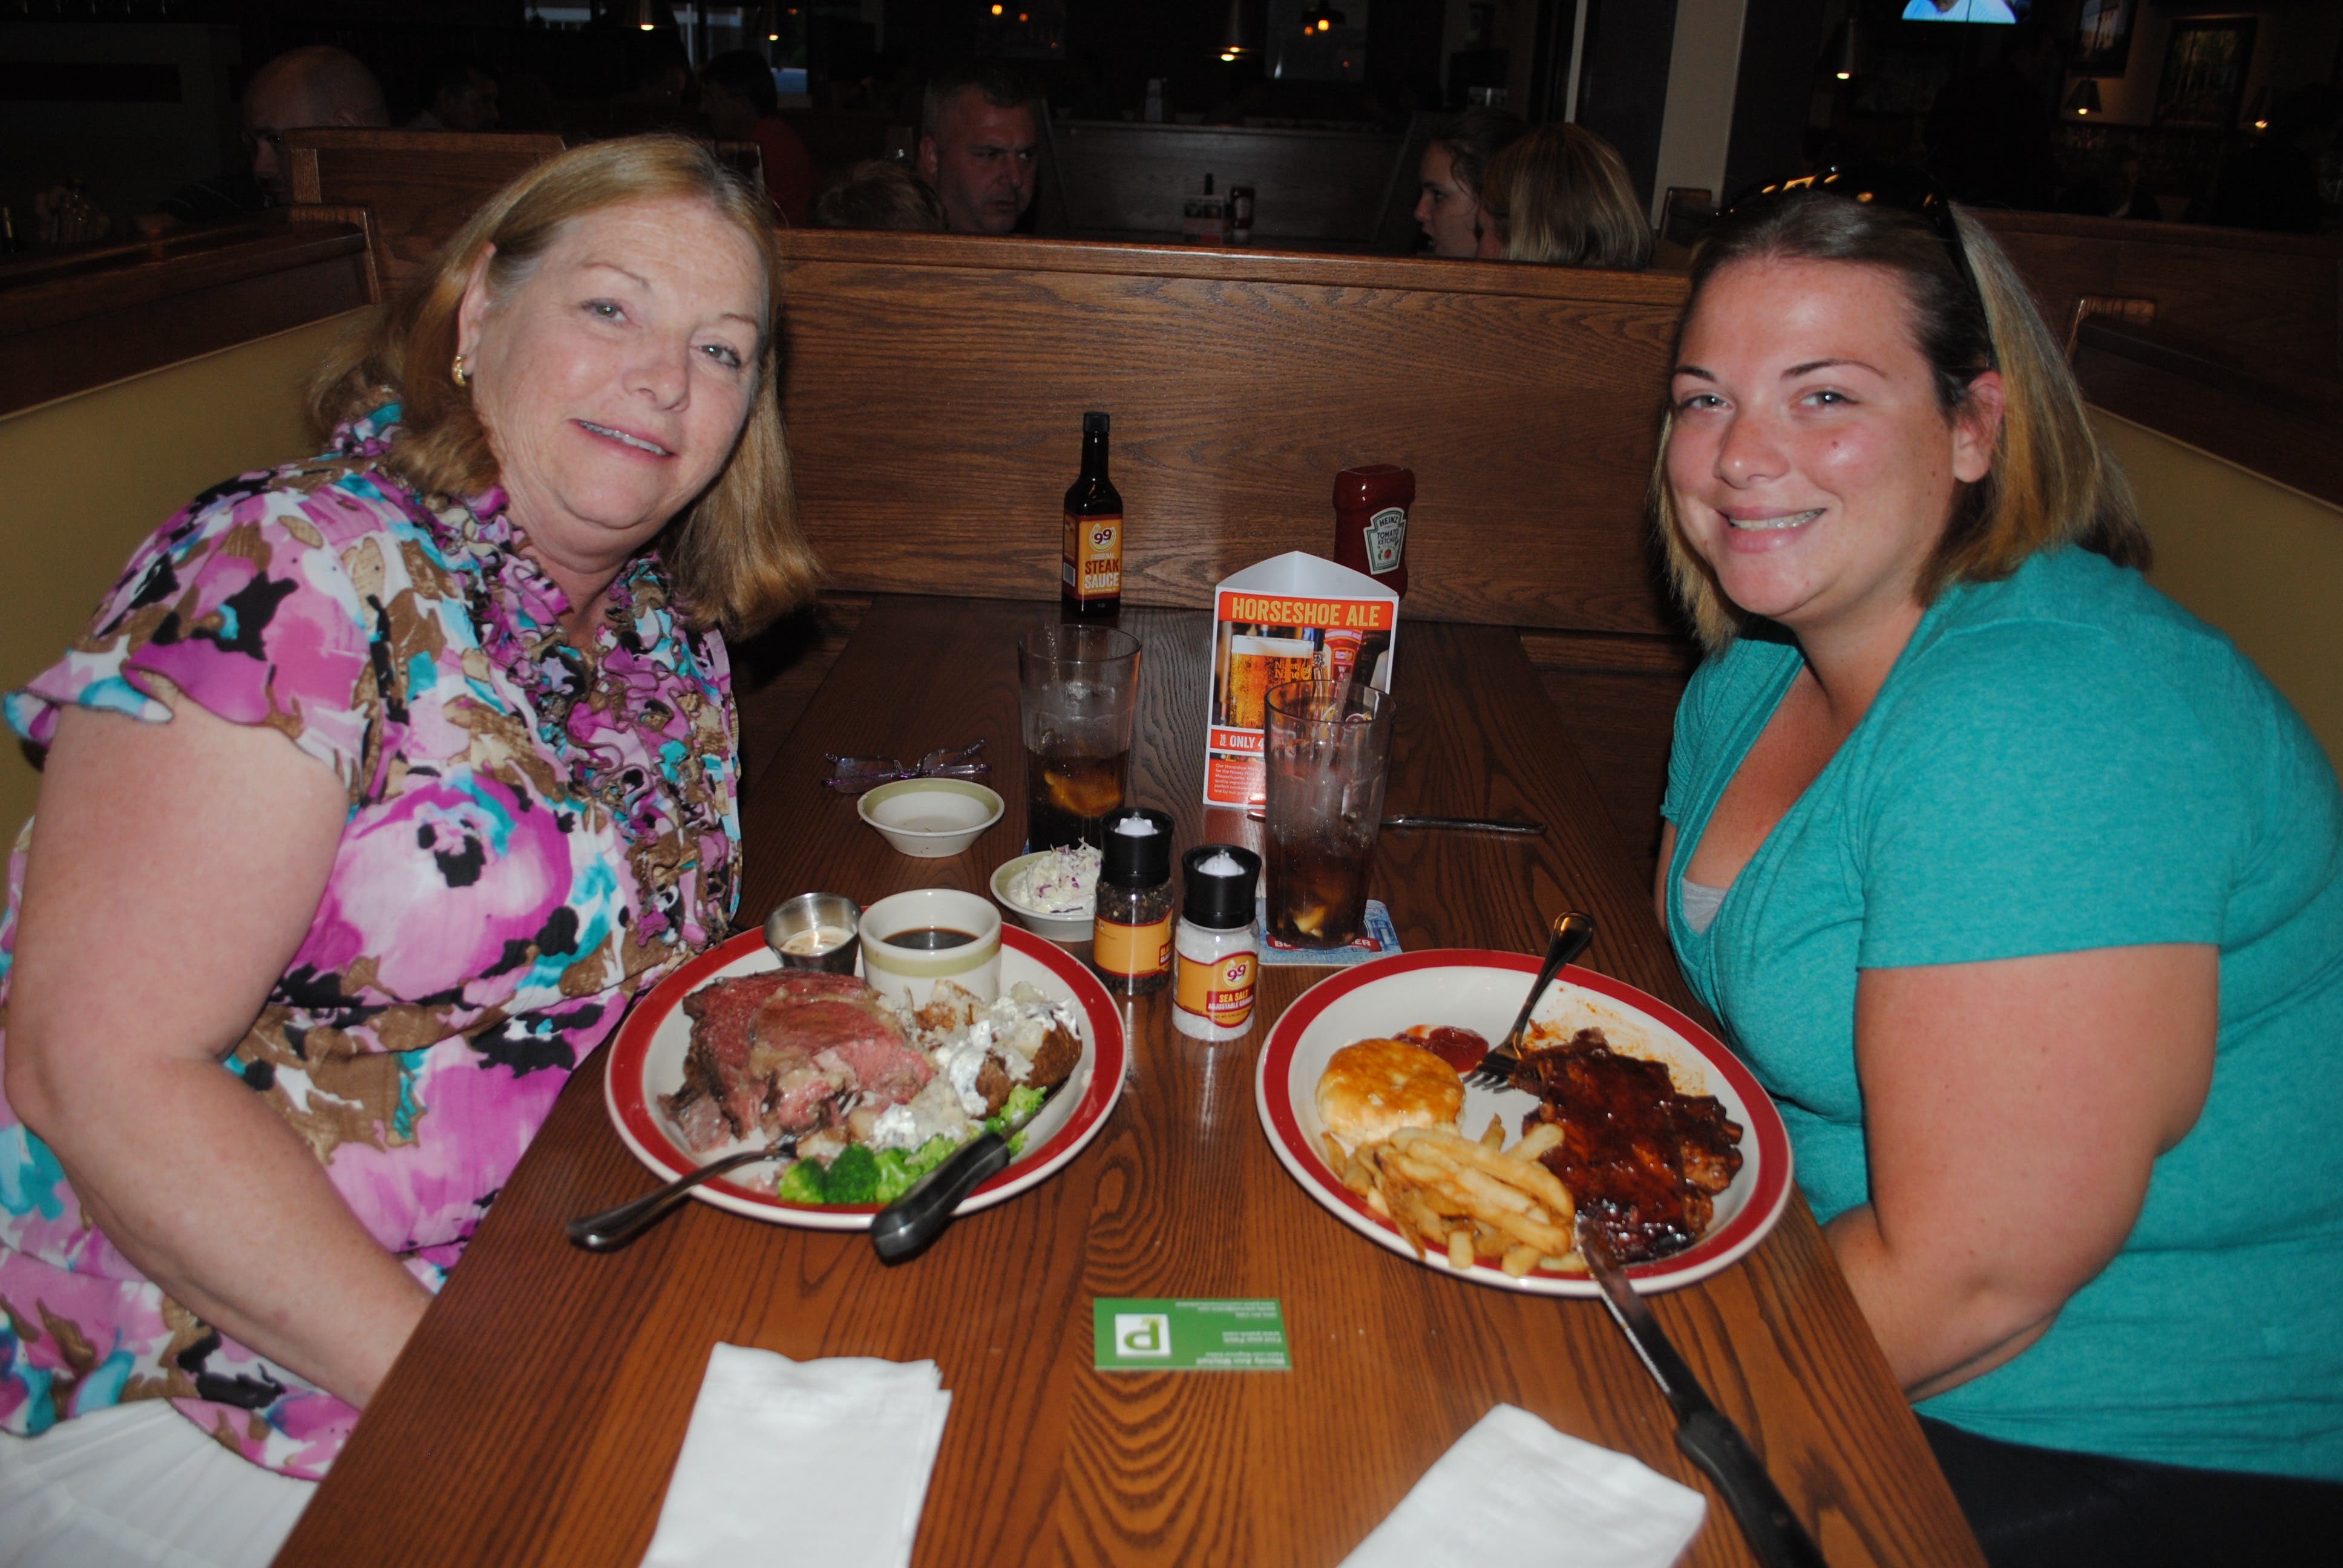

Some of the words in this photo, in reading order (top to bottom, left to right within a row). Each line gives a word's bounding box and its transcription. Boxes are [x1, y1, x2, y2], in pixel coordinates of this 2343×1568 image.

[1378, 516, 1398, 526] HEINZ
[1094, 529, 1112, 544] 99
[1377, 529, 1398, 539] TOMATO
[1085, 558, 1119, 574] STEAK
[1084, 572, 1119, 589] SAUCE
[1231, 597, 1340, 626] HORSESHOE
[1345, 605, 1380, 627] ALE
[1230, 735, 1256, 749] ONLY
[1227, 964, 1247, 982] 99
[1219, 993, 1233, 1003] SEA
[1234, 988, 1249, 1002] SALT
